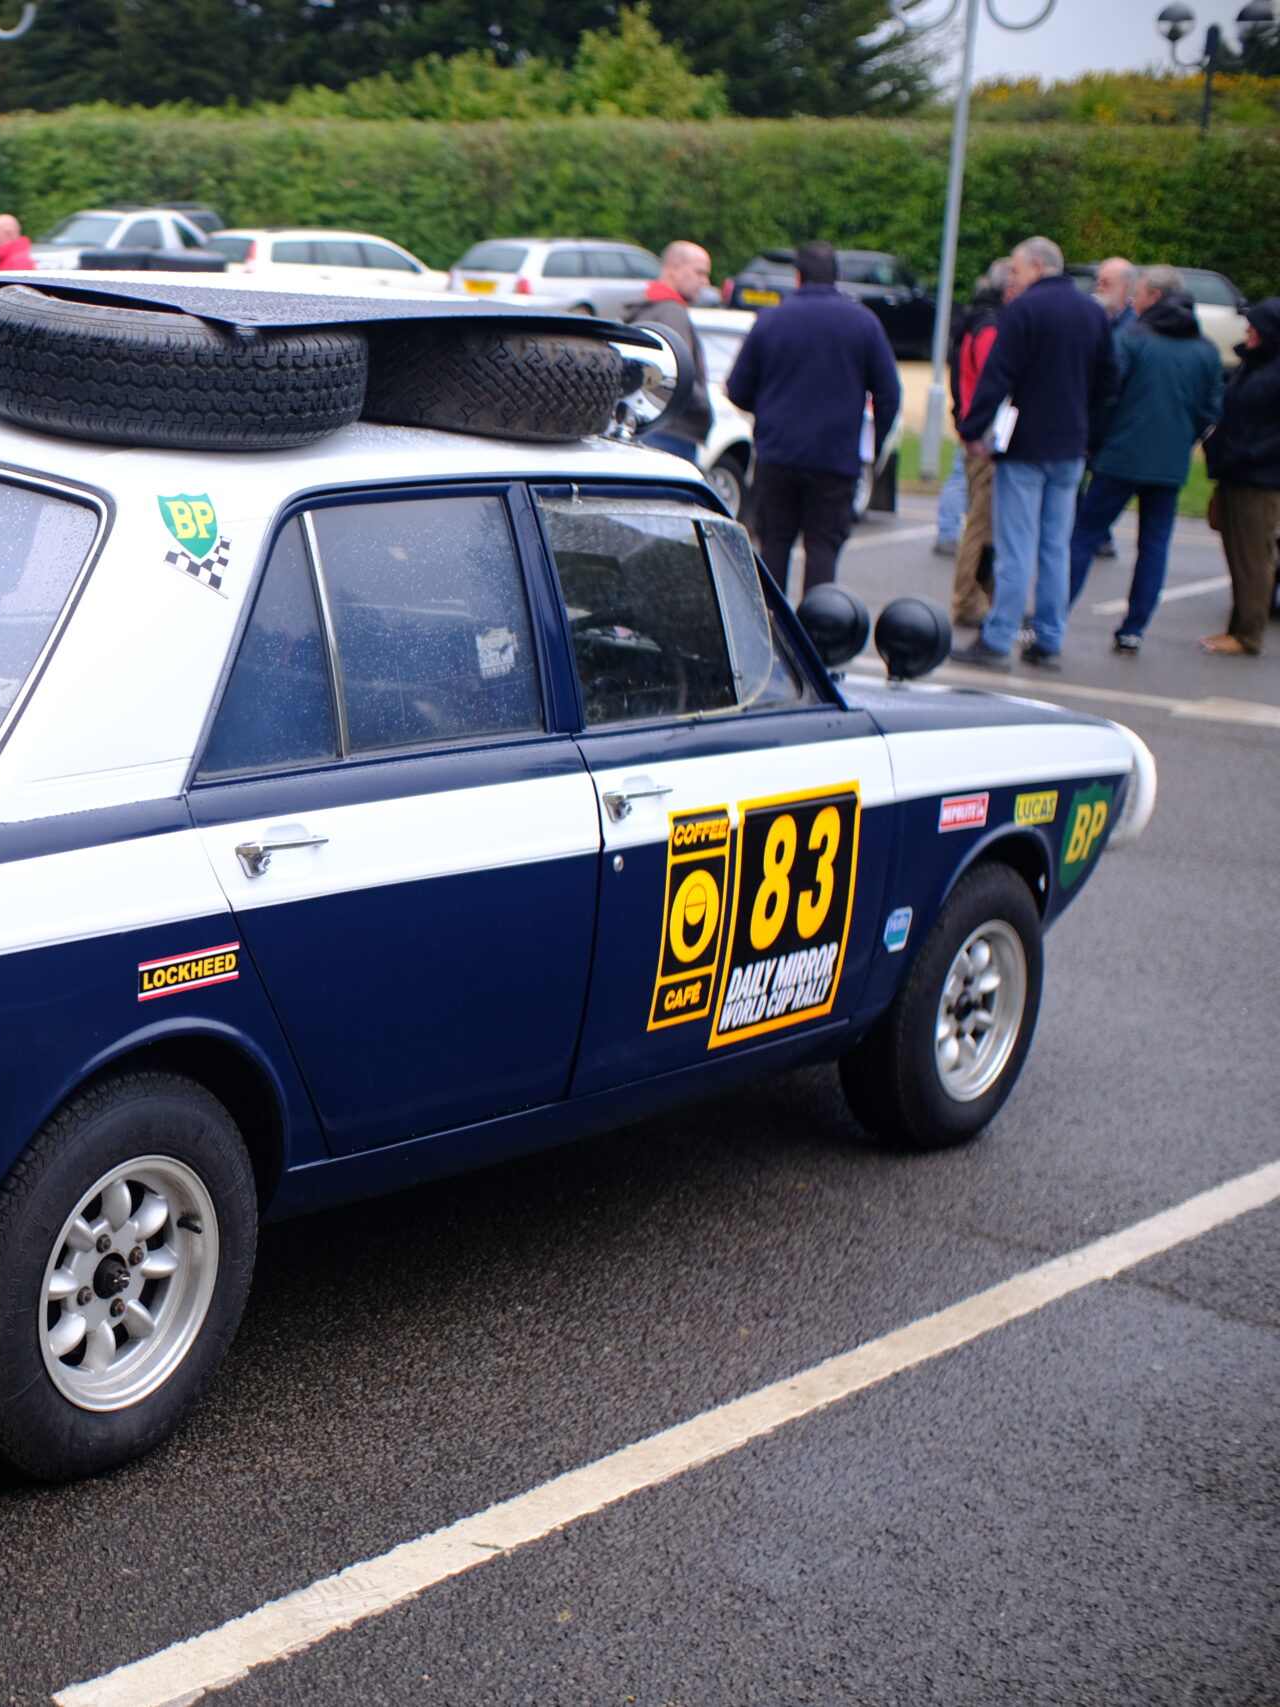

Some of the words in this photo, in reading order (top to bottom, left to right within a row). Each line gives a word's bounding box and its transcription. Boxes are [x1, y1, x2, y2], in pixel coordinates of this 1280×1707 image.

[163, 500, 215, 539] BP
[1016, 796, 1056, 821] LUCAS
[673, 816, 729, 847] COFFEE
[1064, 801, 1108, 865] BP
[750, 805, 841, 950] 83
[142, 953, 237, 991] LOCKHEED
[724, 957, 778, 1004] DAILY
[771, 941, 839, 993] MIRROR
[663, 980, 702, 1012] CAFÉ
[718, 993, 768, 1032] WORLD
[765, 985, 796, 1019] CUP
[790, 974, 833, 1012] RALLY
